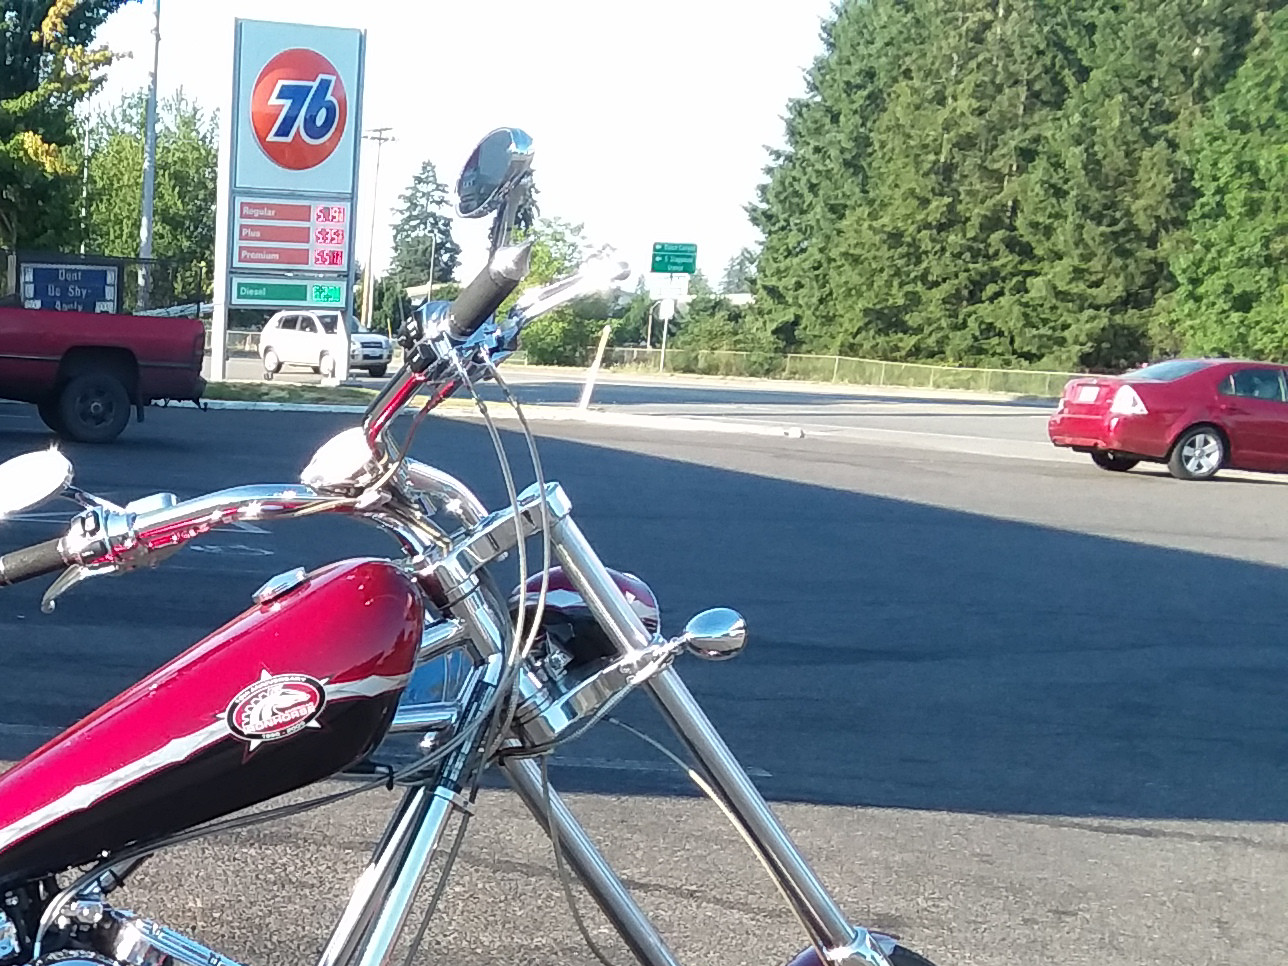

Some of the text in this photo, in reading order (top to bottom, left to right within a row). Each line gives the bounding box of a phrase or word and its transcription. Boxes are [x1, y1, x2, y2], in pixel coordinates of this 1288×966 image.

[267, 74, 339, 144] 76
[242, 206, 276, 217] Regular
[241, 228, 261, 237] Plus
[241, 249, 280, 260] Premium
[240, 286, 266, 297] Diesel
